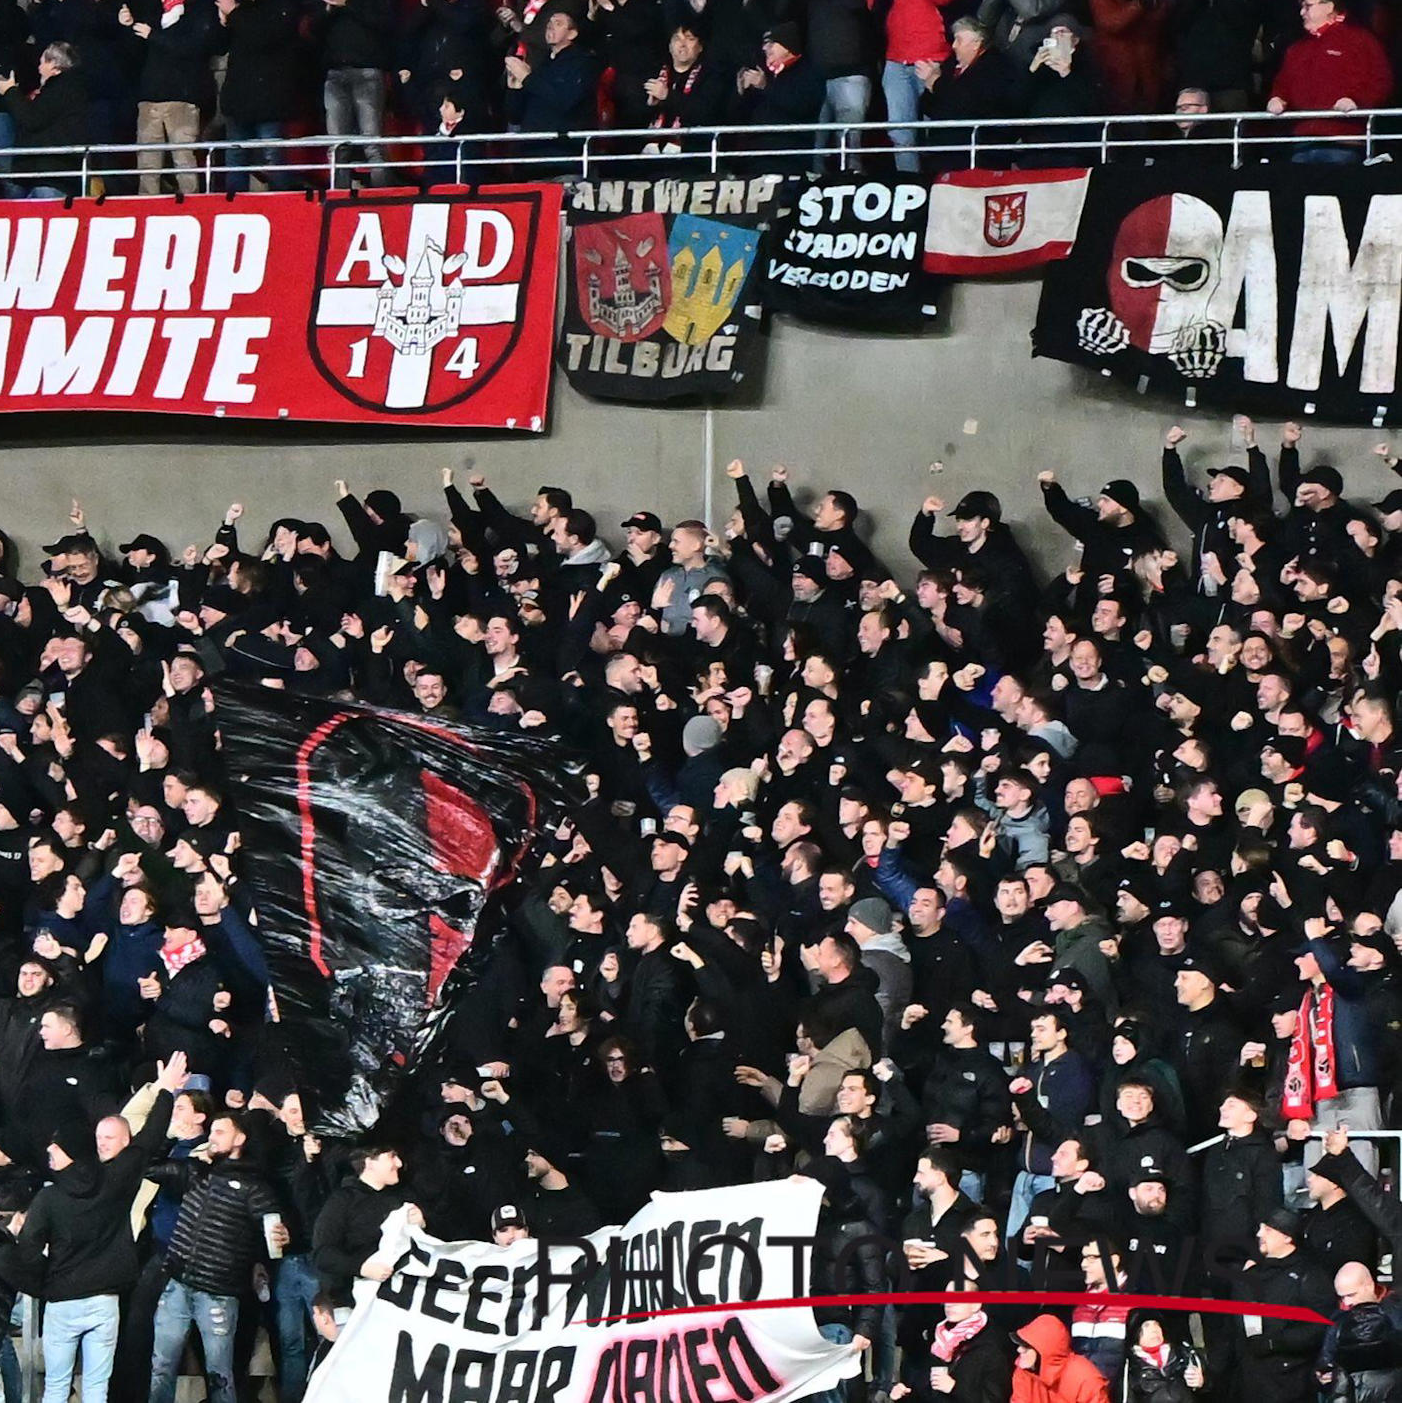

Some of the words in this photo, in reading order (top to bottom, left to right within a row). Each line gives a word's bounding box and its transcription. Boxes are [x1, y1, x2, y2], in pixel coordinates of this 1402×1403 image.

[572, 177, 779, 215] ANTWERP
[798, 182, 927, 227] STOP
[768, 258, 910, 293] VERBODEN
[566, 333, 737, 379] TILBURG
[389, 1329, 578, 1403] MAAR
